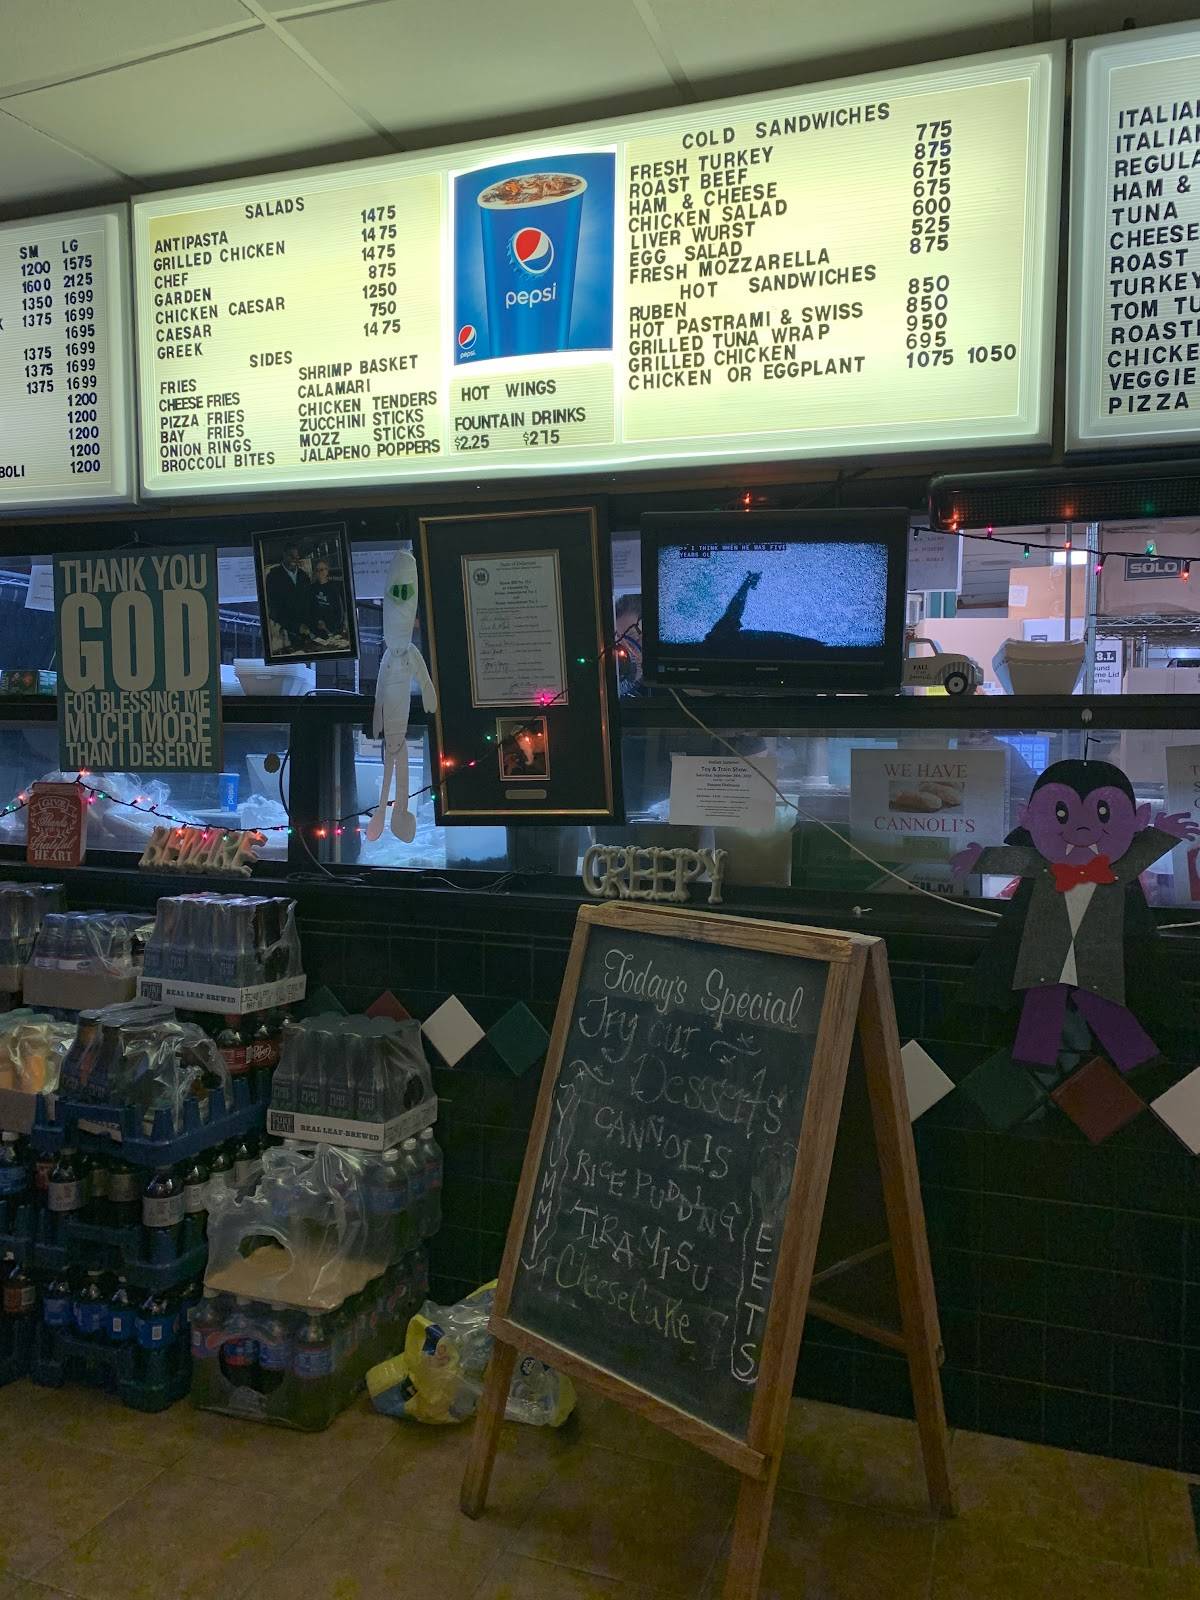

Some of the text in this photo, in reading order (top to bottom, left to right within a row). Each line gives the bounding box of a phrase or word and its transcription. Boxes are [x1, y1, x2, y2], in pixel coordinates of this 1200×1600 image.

[682, 103, 889, 149] COLD SANDWICHES
[631, 120, 952, 181] FRESH TURKEY 775
[630, 139, 951, 199] ROAST BEEF 875
[629, 158, 951, 216] HAM & CHEESE 675
[1113, 175, 1191, 202] HAM &
[245, 197, 304, 219] SALADS
[629, 199, 787, 233] CHICKEN SALAD
[1112, 201, 1178, 226] TUNA
[155, 205, 396, 254] ANTIPASTA 1475
[631, 196, 951, 250] LIVER WURST 600
[20, 239, 78, 259] SM LG
[154, 224, 397, 271] GRILLED CHICKEN 1475
[630, 215, 950, 267] EGG SALAD 525
[1110, 223, 1199, 250] CHEESE
[21, 255, 92, 276] 1200 1575
[154, 243, 395, 289] CHEF 1475
[630, 234, 948, 284] FRESH MOZZARELLA 875
[1111, 248, 1188, 274] ROAST
[22, 272, 92, 293] 1600 2125
[154, 263, 396, 307] GARDEN 875
[505, 282, 557, 308] pepsi
[680, 265, 876, 300] HOT SANDWICHES
[22, 290, 93, 311] 1350 1699
[156, 282, 397, 324] CHICKEN CAESAR 1250
[630, 275, 949, 322] RUBEN 850
[1110, 300, 1158, 321] TOM
[22, 312, 52, 327] 1375
[65, 324, 95, 339] 1695
[156, 301, 396, 342] CAESAR 750
[630, 302, 863, 339] HOT PASTRAMI & SWISS
[157, 319, 401, 360] GREEK 1475
[629, 312, 947, 356] GRILLED TUNA WRAP 950
[250, 351, 292, 368] SIDES
[629, 331, 946, 373] GRILLED CHICKEN 695
[299, 354, 418, 381] SHRIMP BASKET
[629, 344, 1016, 391] CHICKEN OR EGGPLANT 1075 1050
[1109, 367, 1196, 390] VEGGIE
[68, 392, 97, 406] 1200
[161, 379, 197, 394] FRIES
[298, 379, 370, 398] CALAMARI
[461, 379, 556, 402] HOT WINGS
[159, 392, 240, 412] CHEESE FRIES
[298, 391, 437, 417] CHICKEN TENDERS
[1109, 392, 1189, 414] PIZZA
[161, 410, 244, 429] PIZZA FRIES
[300, 409, 423, 432] ZUCCHINI STICKS
[455, 407, 586, 431] FOUNTAIN DRINKS
[161, 424, 244, 443] BAY FRIES
[300, 424, 424, 447] MOZZ STICKS
[160, 439, 251, 458] ONION RINGS
[300, 439, 440, 462] JALAPENO POPPERS
[162, 452, 275, 472] BROCCOLI BITES
[59, 557, 145, 595] THANK
[152, 553, 208, 591] YOU
[1130, 562, 1178, 574] SOLO
[60, 589, 210, 692] GOD
[64, 690, 210, 714] FOR BLESSING ME
[65, 712, 211, 744] MUCH MORE
[66, 742, 212, 767] THAN I DESERVE
[884, 764, 967, 778] WE HAVE
[874, 816, 976, 833] CANNOLI'S
[34, 849, 72, 861] HEART
[604, 949, 804, 1031] Today's Special
[300, 1124, 322, 1133] REAL
[594, 1106, 733, 1179] CANNOLIS
[572, 1148, 627, 1197] RICE
[569, 1199, 714, 1292] TIRAMISU
